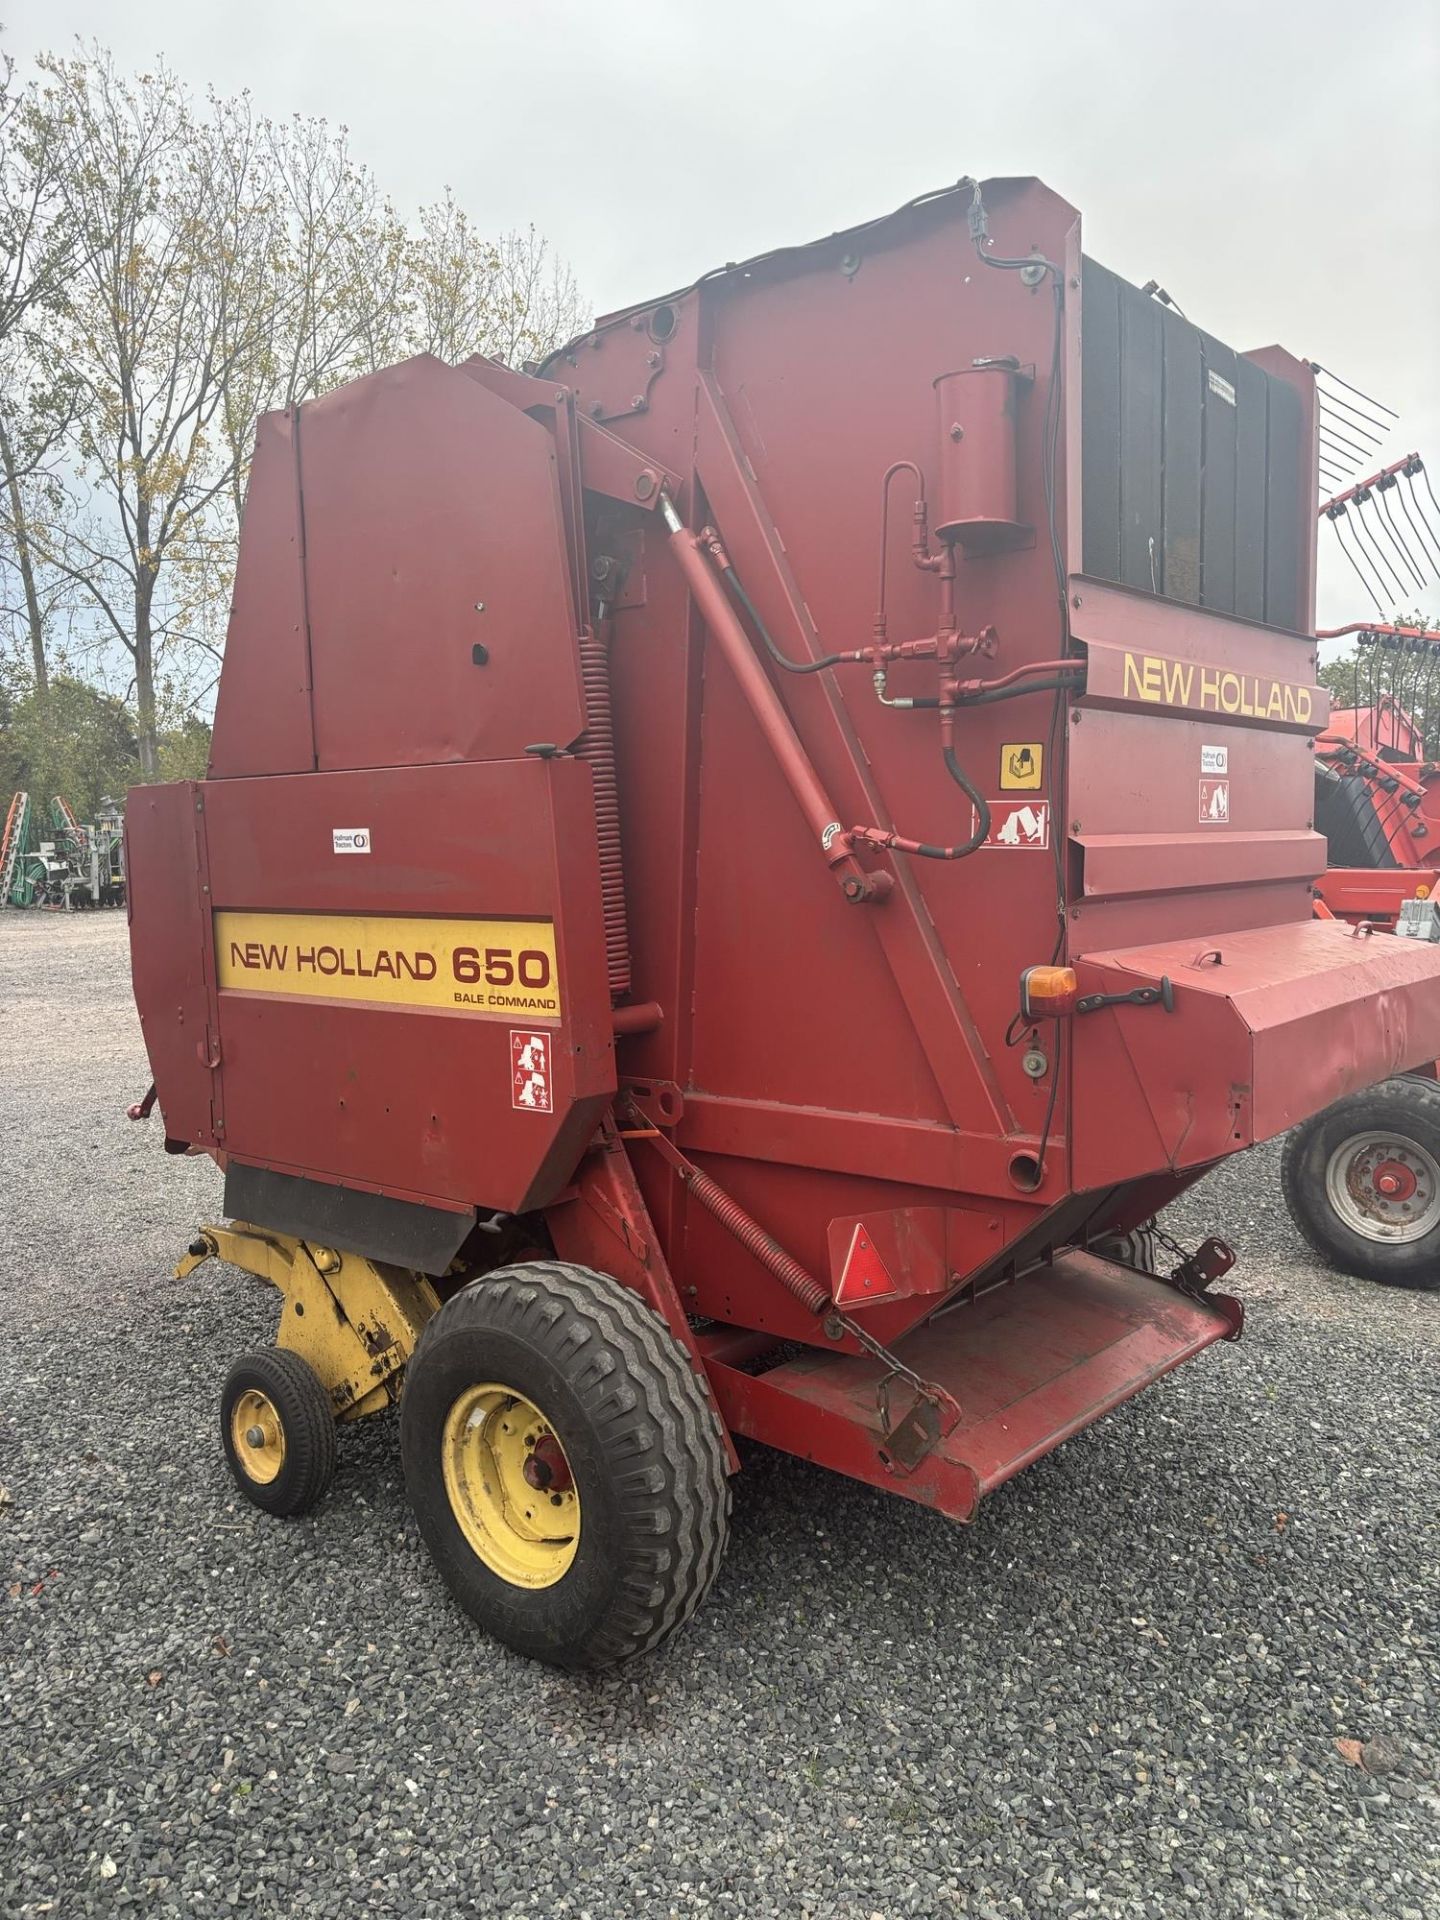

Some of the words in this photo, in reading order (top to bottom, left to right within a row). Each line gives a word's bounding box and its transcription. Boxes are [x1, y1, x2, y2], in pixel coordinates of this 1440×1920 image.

[1123, 652, 1194, 706] NEW
[1201, 668, 1312, 724] HOLLAND
[230, 942, 288, 971] NEW
[297, 945, 437, 980] HOLLAND
[452, 947, 550, 989] 650
[453, 992, 485, 1005] BALE
[488, 995, 557, 1010] COMMAND
